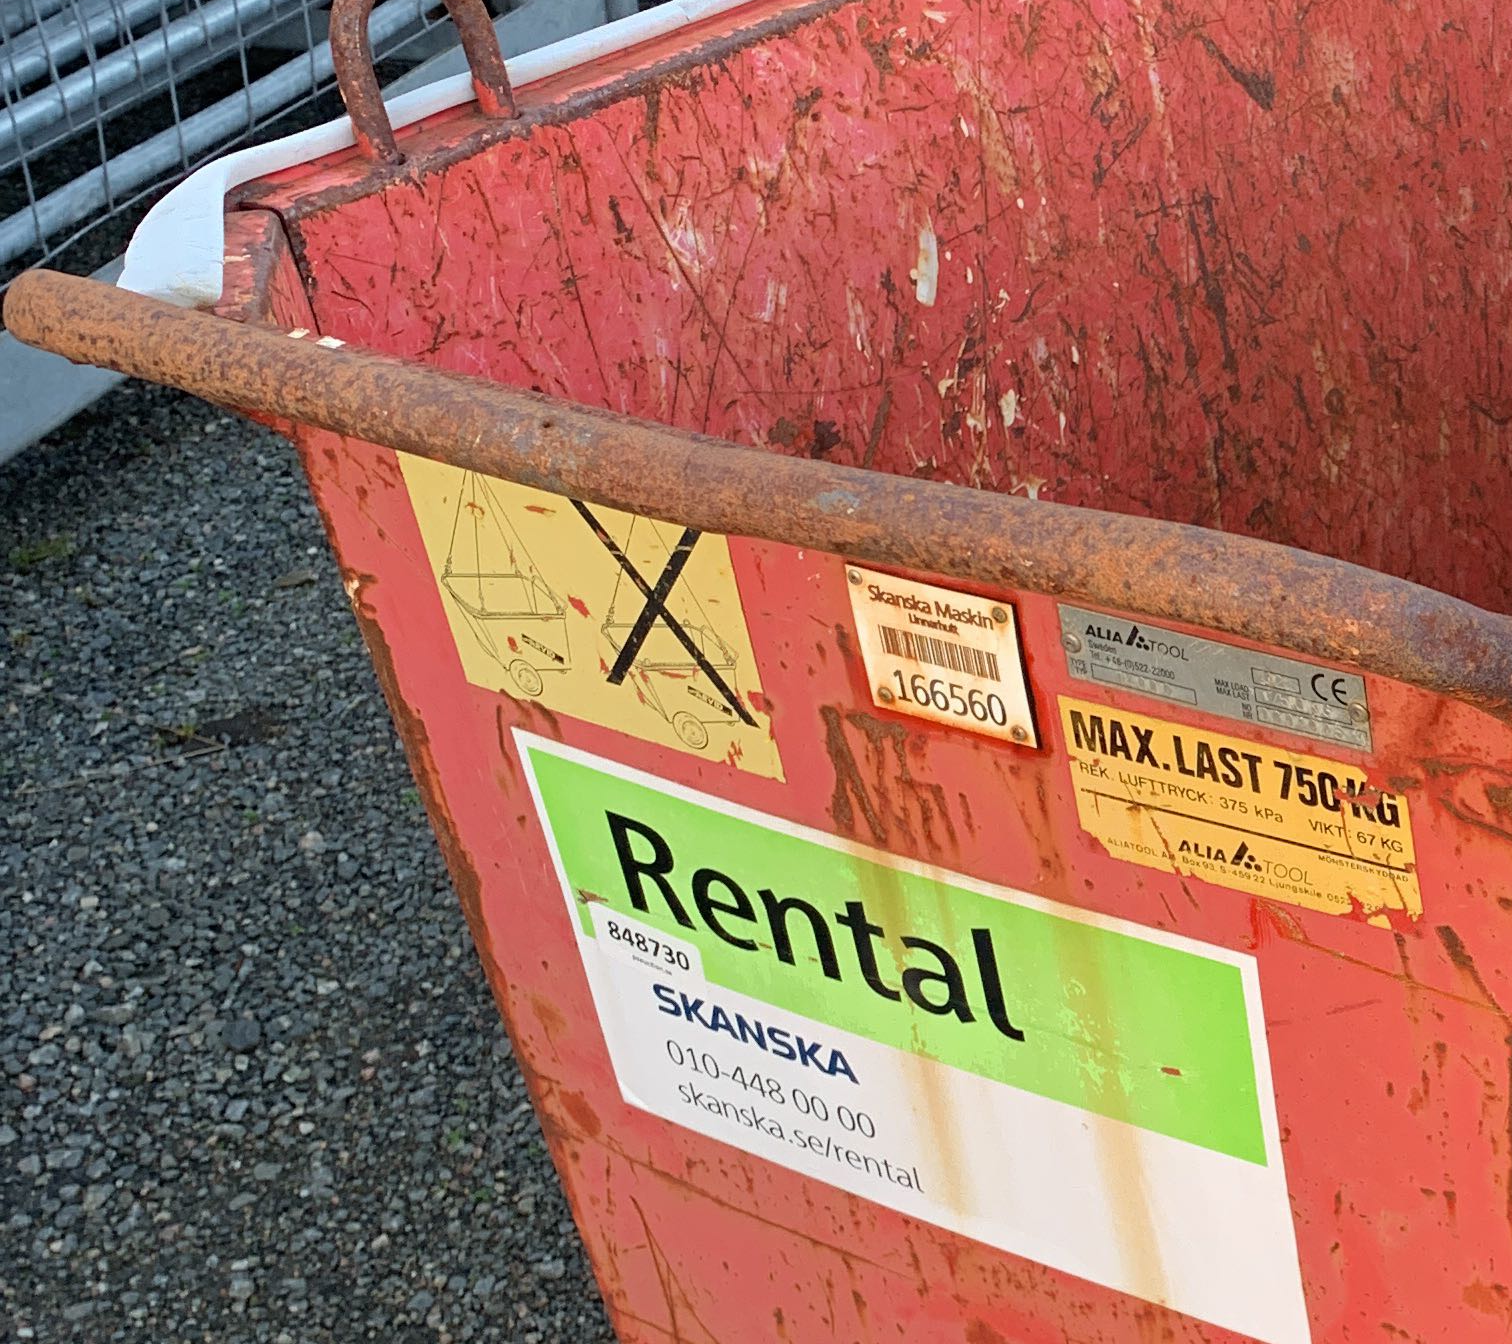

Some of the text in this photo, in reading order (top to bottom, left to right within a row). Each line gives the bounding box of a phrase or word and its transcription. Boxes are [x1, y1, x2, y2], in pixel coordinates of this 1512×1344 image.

[867, 584, 994, 630] Skanska Maskin
[1085, 624, 1189, 662] ALIA TOOL
[893, 669, 1008, 727] 166560
[1311, 673, 1348, 706] CE
[1272, 760, 1341, 813] 750
[1219, 796, 1248, 815] 375
[1254, 805, 1284, 823] kPa
[1356, 831, 1376, 846] 67
[1380, 836, 1404, 854] KG
[1178, 839, 1314, 886] ALIA TOOL
[604, 809, 1026, 1043] Rental
[607, 920, 690, 971] 848730
[652, 983, 860, 1086] SKANSKA
[666, 1038, 876, 1139] 010-448 00 00
[678, 1081, 925, 1194] skanska.se/rental
